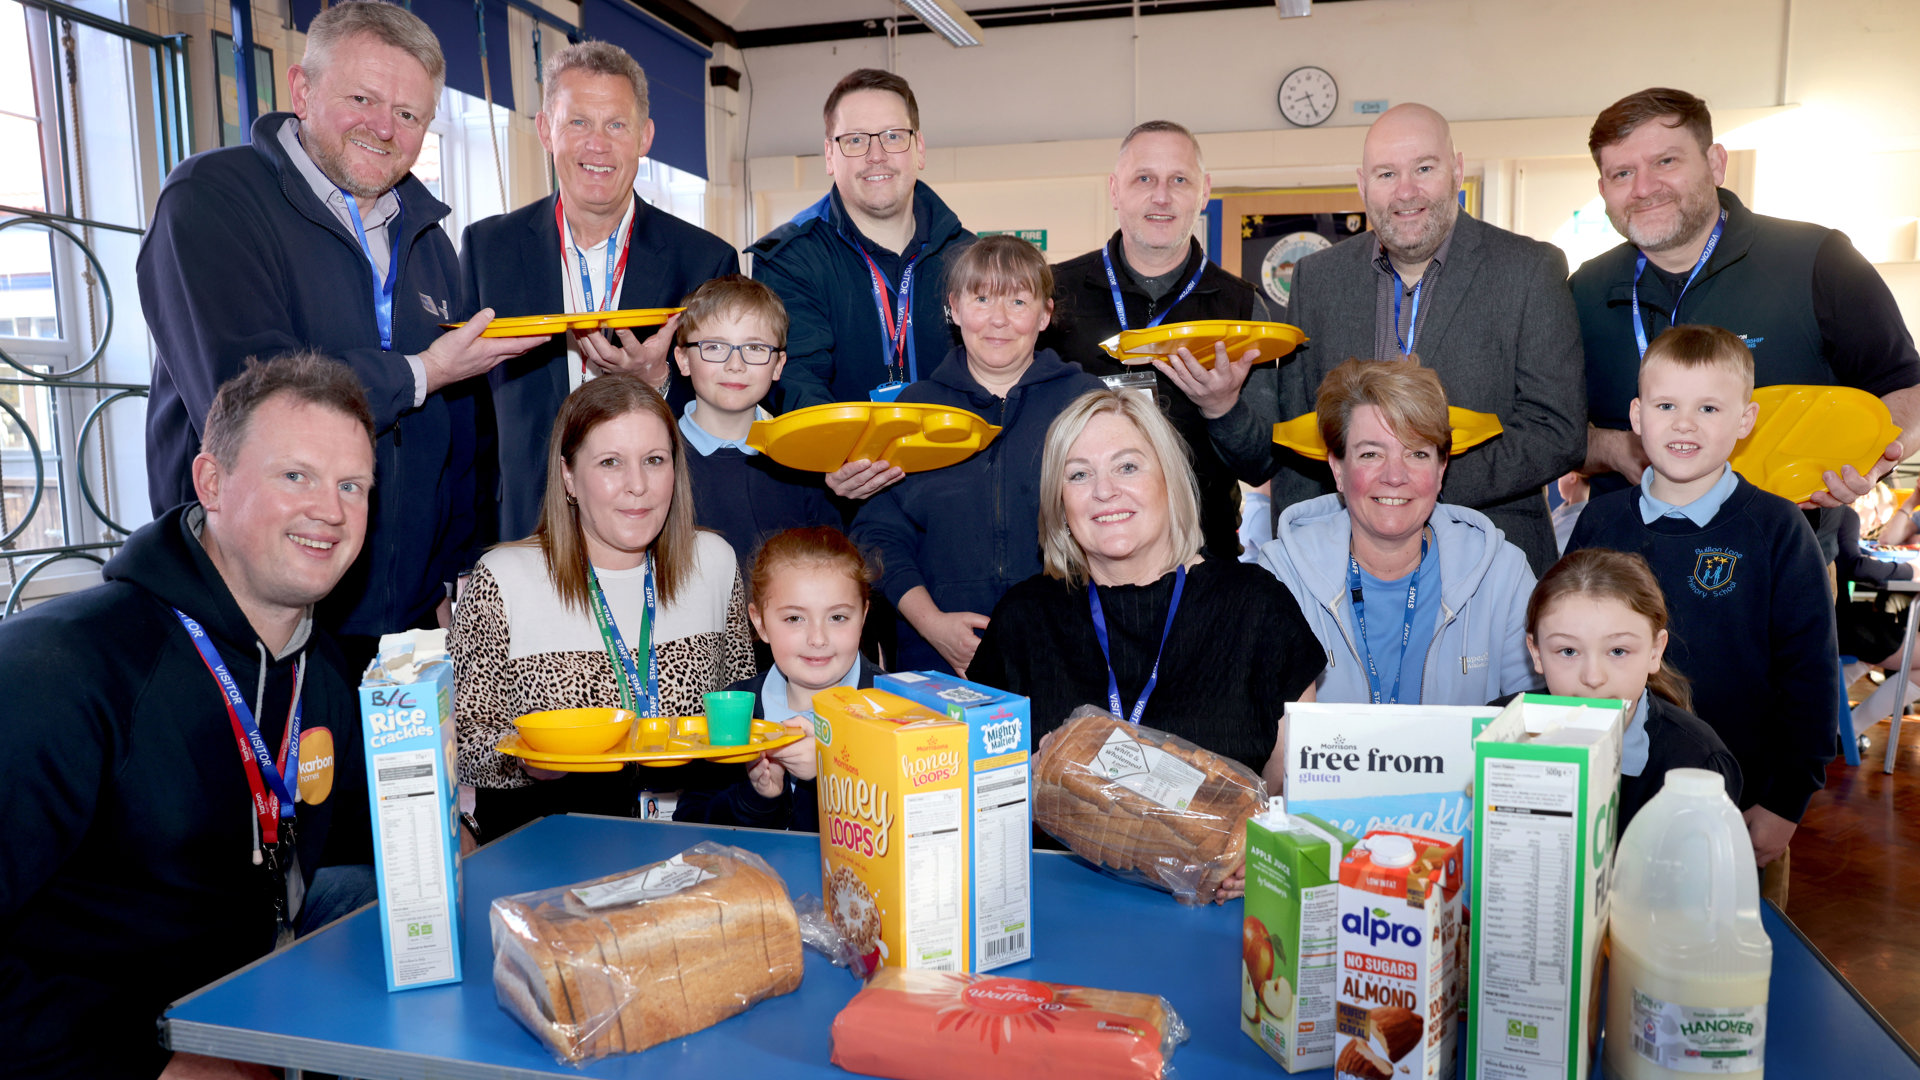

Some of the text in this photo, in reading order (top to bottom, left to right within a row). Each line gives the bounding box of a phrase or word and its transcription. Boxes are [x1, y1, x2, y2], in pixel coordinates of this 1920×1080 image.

[1021, 231, 1042, 240] FIRE
[1701, 234, 1719, 263] VISITOR
[900, 262, 915, 295] VISITOR
[1106, 266, 1117, 286] VISITOR
[892, 306, 905, 342] VISITOR
[1115, 301, 1127, 327] VISITOR
[1695, 546, 1743, 559] Bullion Lane
[646, 586, 654, 608] STAFF
[1407, 586, 1417, 609] STAFF
[1687, 575, 1736, 598] Primary School
[1402, 622, 1411, 646] STAFF
[615, 639, 630, 661] STAFF
[1367, 653, 1377, 676] STAFF
[214, 664, 243, 705] VISITOR
[630, 673, 644, 697] STAFF
[371, 688, 417, 709] B/C
[1109, 693, 1122, 719] VISIT
[368, 708, 427, 735] Rice
[1131, 700, 1145, 725] VISIT
[290, 716, 301, 758] VISITOR
[370, 724, 434, 748] Crackles
[987, 723, 1018, 743] Mighty
[991, 737, 1016, 750] Malties
[239, 737, 250, 762] karbon
[249, 729, 272, 767] VISITOR
[1299, 746, 1445, 774] free from
[298, 754, 333, 774] karbon
[833, 756, 860, 776] Morrisons
[901, 749, 963, 779] honey
[913, 768, 951, 788] LOOPS
[1298, 771, 1342, 784] gluten
[255, 792, 266, 815] karbon
[817, 750, 895, 858] honey
[827, 814, 875, 859] LOOPS
[1250, 845, 1272, 864] APPLE
[1273, 858, 1290, 877] JUICE
[1341, 906, 1422, 947] alpro
[1346, 953, 1415, 978] NO SUGARS
[968, 988, 1046, 1004] Waffles
[1342, 976, 1417, 1012] ALMOND
[1339, 1004, 1368, 1021] PERFECT
[1339, 1022, 1367, 1039] CEREAL
[1680, 1020, 1755, 1036] HANOVER
